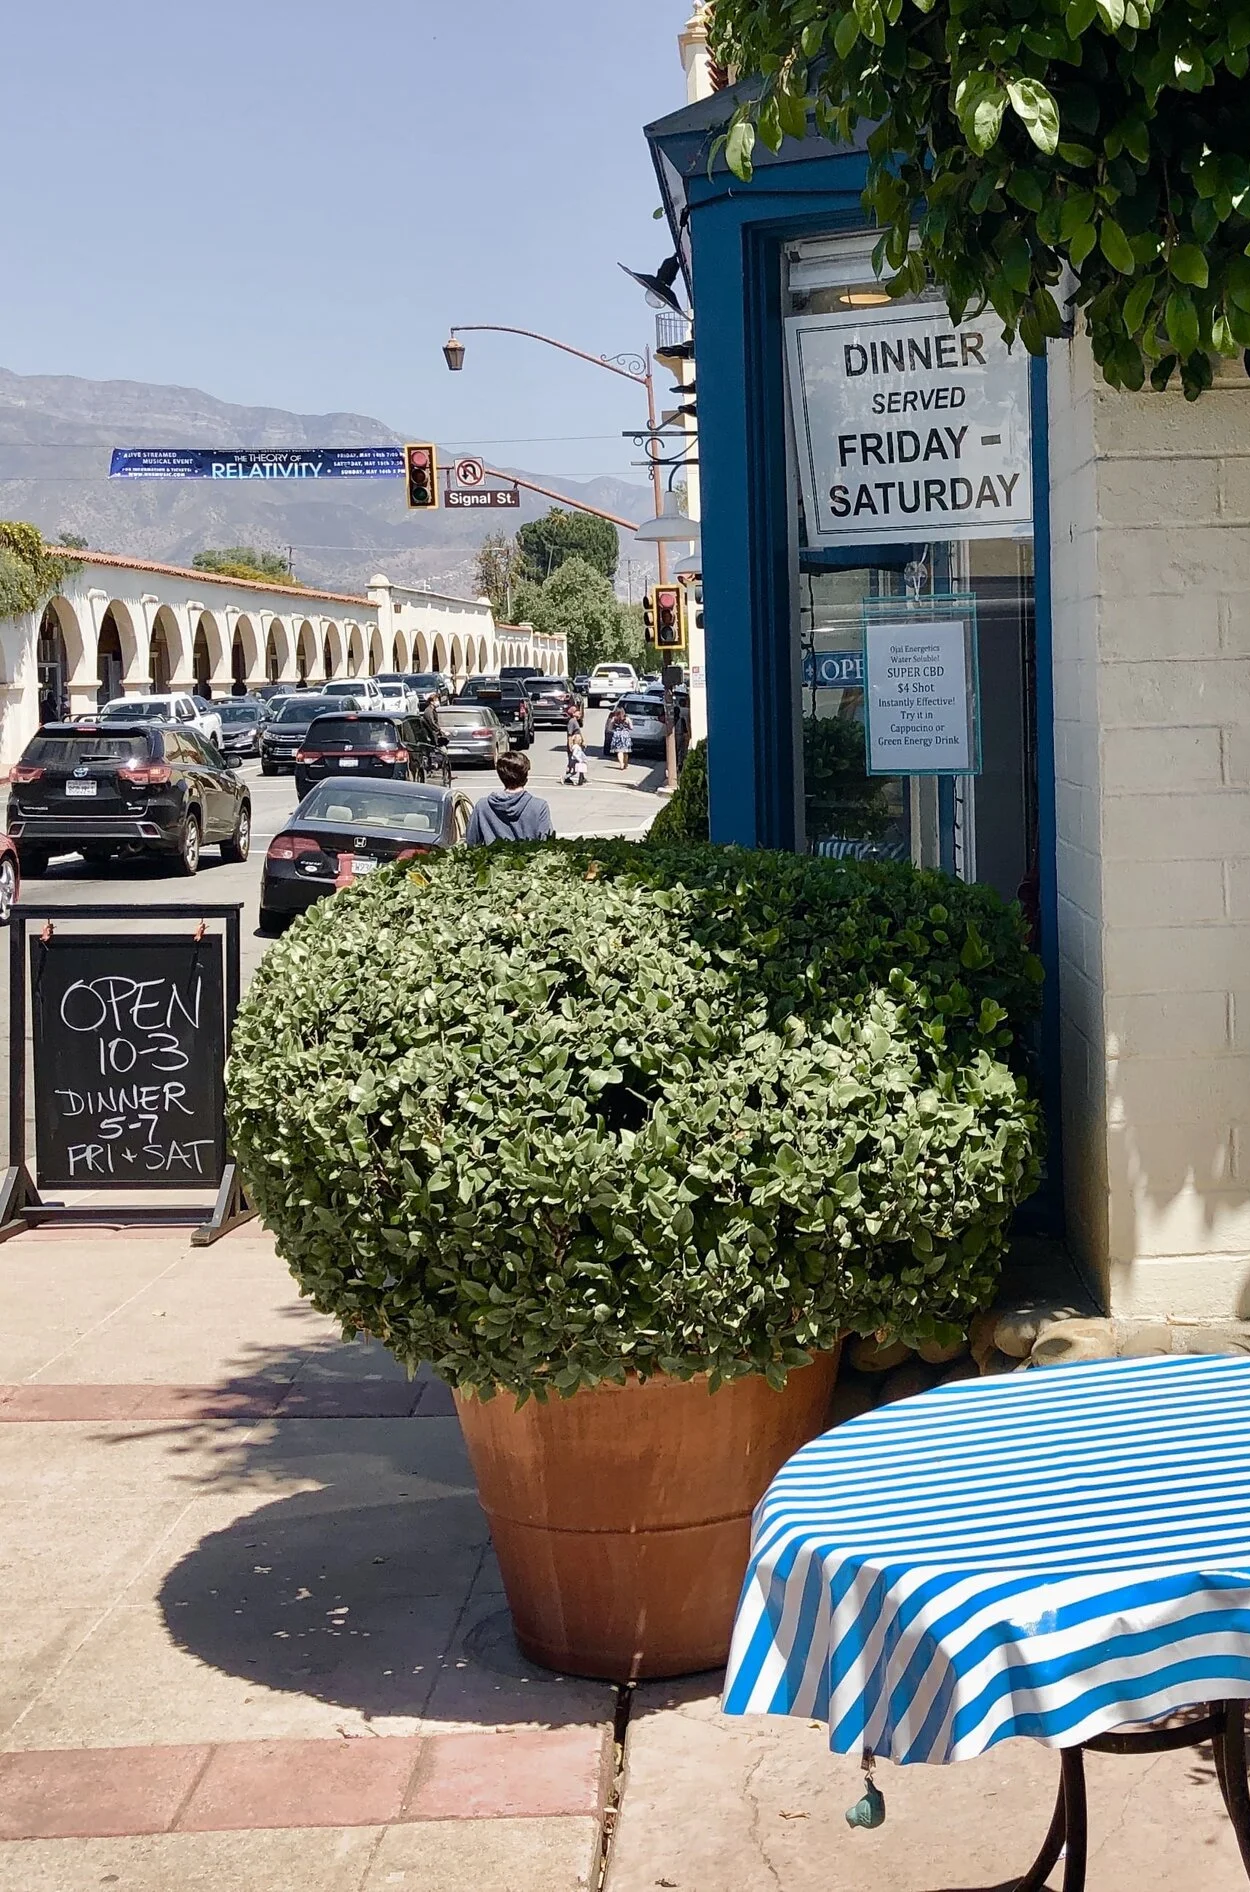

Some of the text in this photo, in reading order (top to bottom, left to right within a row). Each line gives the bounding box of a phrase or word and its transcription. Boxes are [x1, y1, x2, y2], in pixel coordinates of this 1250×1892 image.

[844, 332, 986, 378] DINNER
[872, 386, 966, 414] SERVED
[838, 426, 968, 468] FRIDAY
[249, 454, 288, 462] THEORY
[212, 462, 323, 479] RELATIVITY
[449, 492, 515, 506] Signal St.
[830, 473, 1020, 518] SATURDAY
[890, 645, 940, 654] Ojai Energetics
[822, 659, 864, 680] OPE
[887, 666, 945, 678] SUPER CBD
[898, 682, 935, 693] $4 Shot
[879, 697, 956, 708] Instantly Effective!
[900, 711, 915, 721] Try
[890, 724, 934, 735] Cappucino
[878, 735, 960, 748] Green Energy Drink
[60, 976, 202, 1032] OPEN
[98, 1033, 190, 1076] 10-3
[55, 1082, 195, 1116] DINNER
[98, 1114, 158, 1144] 5-7
[68, 1142, 114, 1176] FRI
[143, 1140, 214, 1174] SAT
